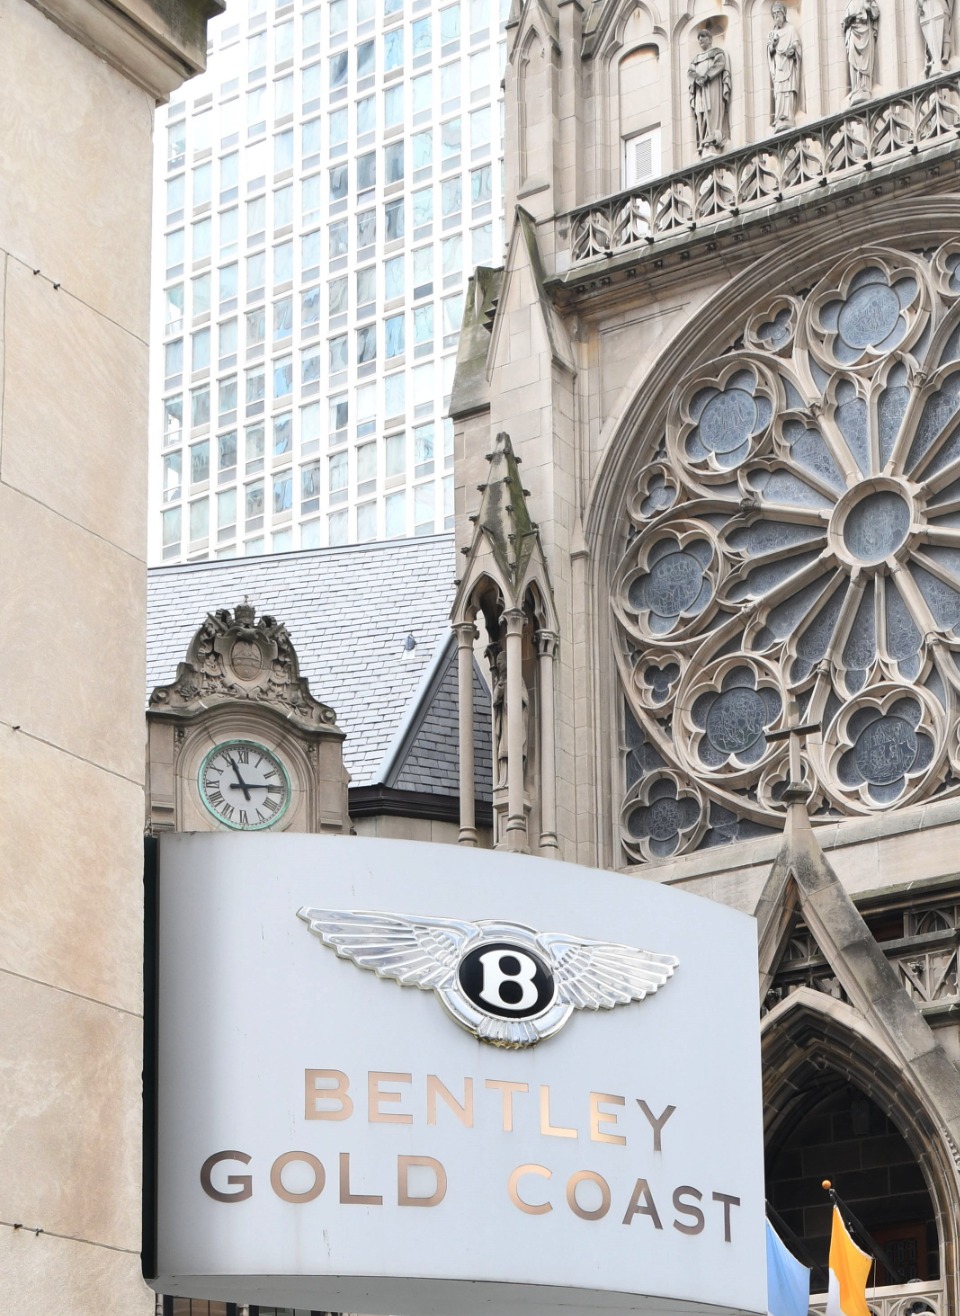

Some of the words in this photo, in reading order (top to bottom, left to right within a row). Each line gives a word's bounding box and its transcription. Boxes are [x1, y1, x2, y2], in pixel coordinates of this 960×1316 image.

[479, 949, 538, 1011] B
[305, 1068, 677, 1152] BENTLEY
[200, 1150, 448, 1208] GOLD
[507, 1163, 741, 1243] COAST
